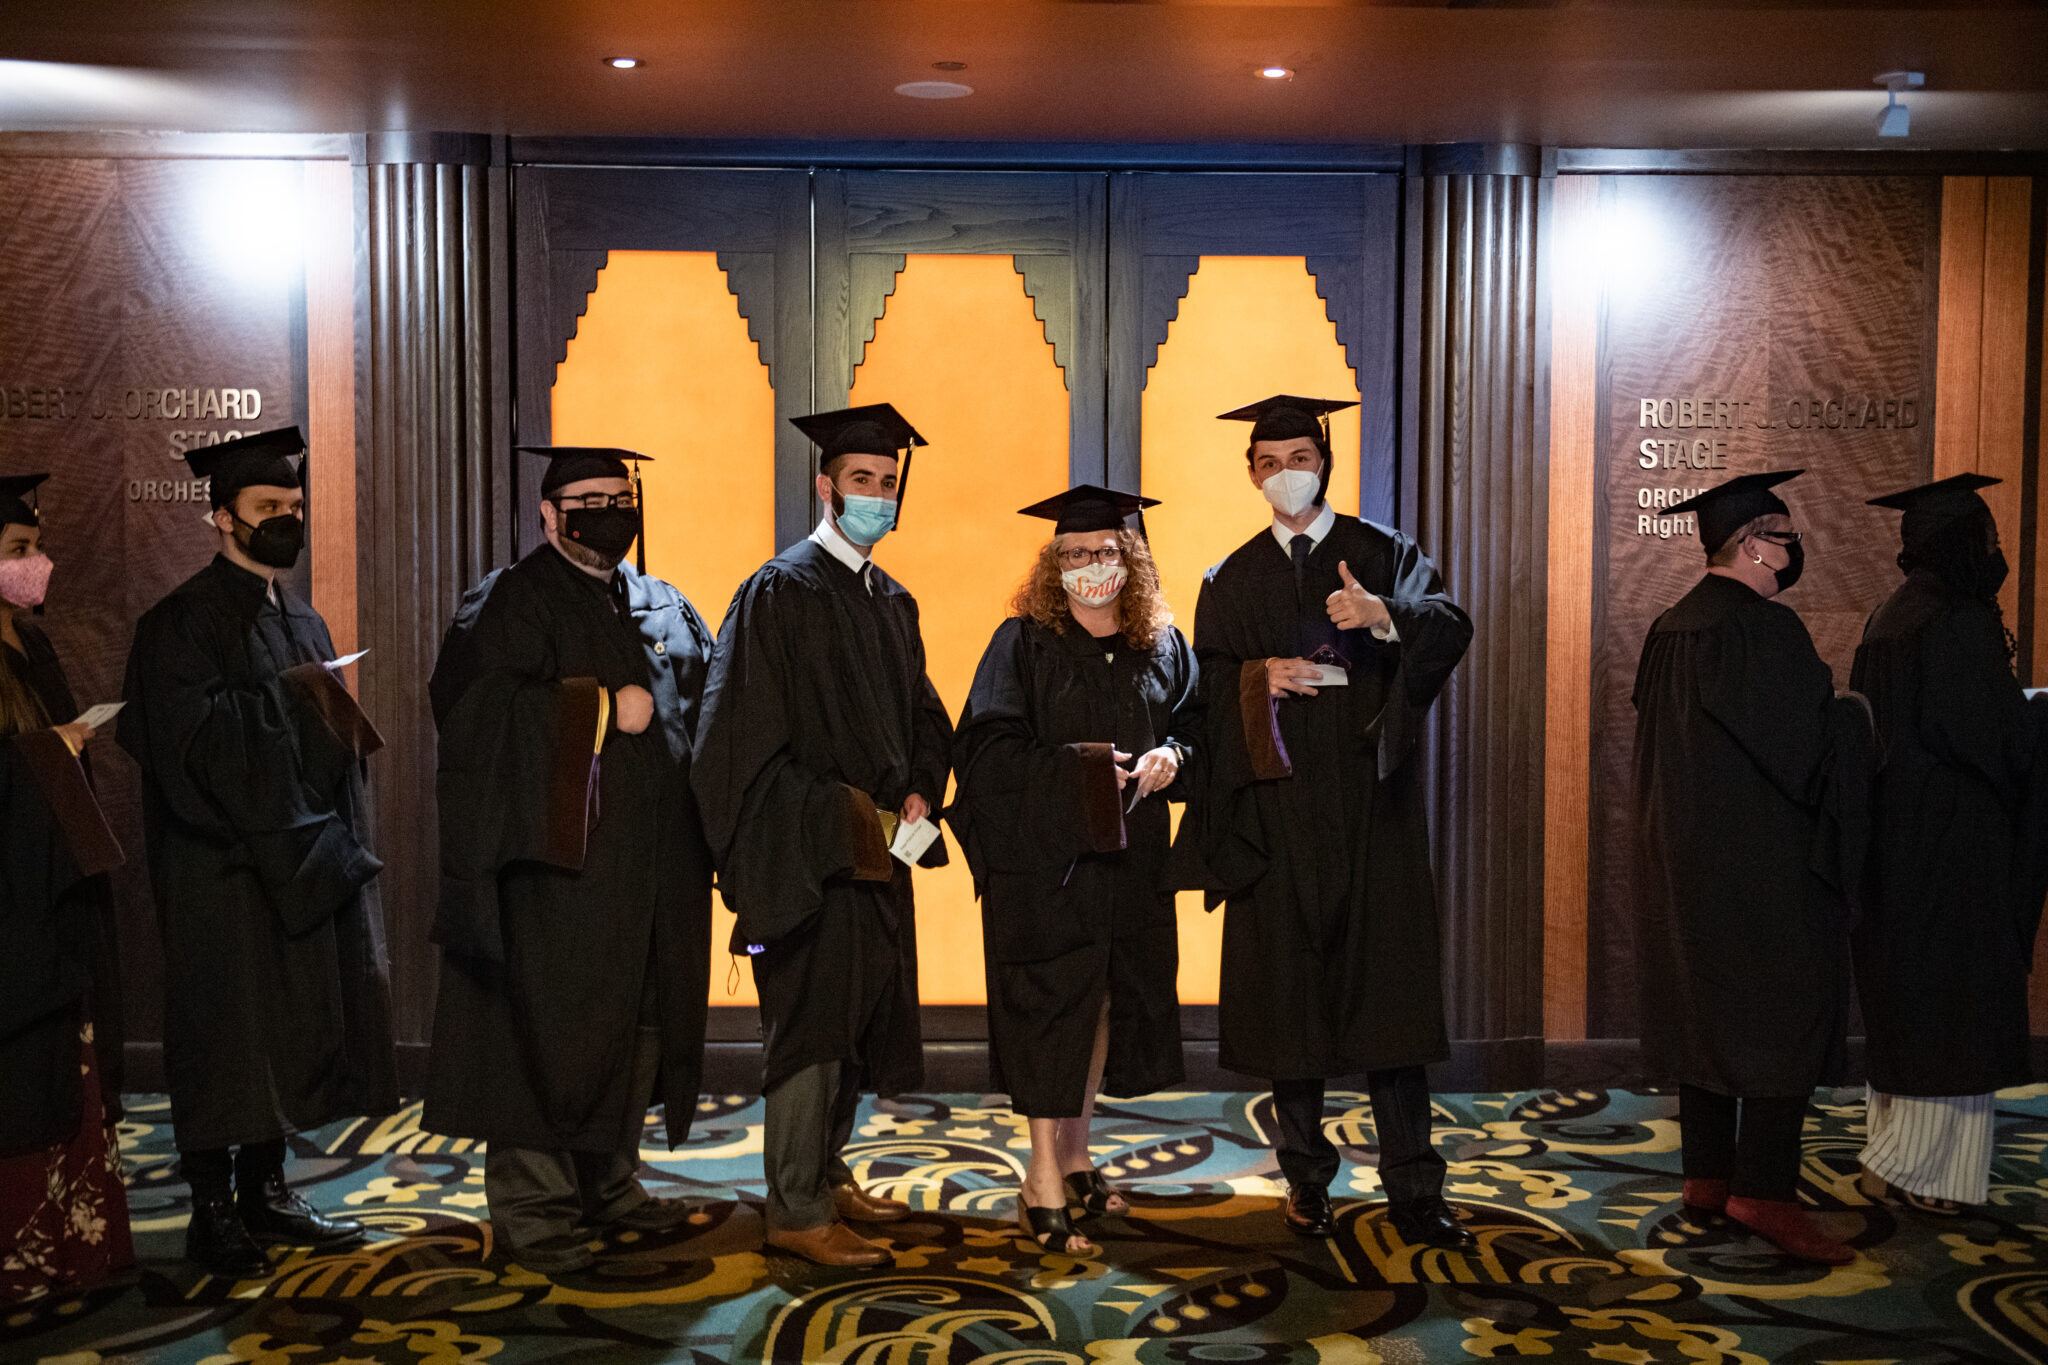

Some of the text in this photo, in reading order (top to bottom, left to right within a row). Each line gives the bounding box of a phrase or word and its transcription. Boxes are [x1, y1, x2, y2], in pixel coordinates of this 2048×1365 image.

[124, 388, 262, 420] ORCHARD
[1638, 398, 1750, 428] ROBERT
[1786, 398, 1920, 429] ORCHARD
[1638, 439, 1727, 470] STAGE
[1637, 514, 1694, 540] Right
